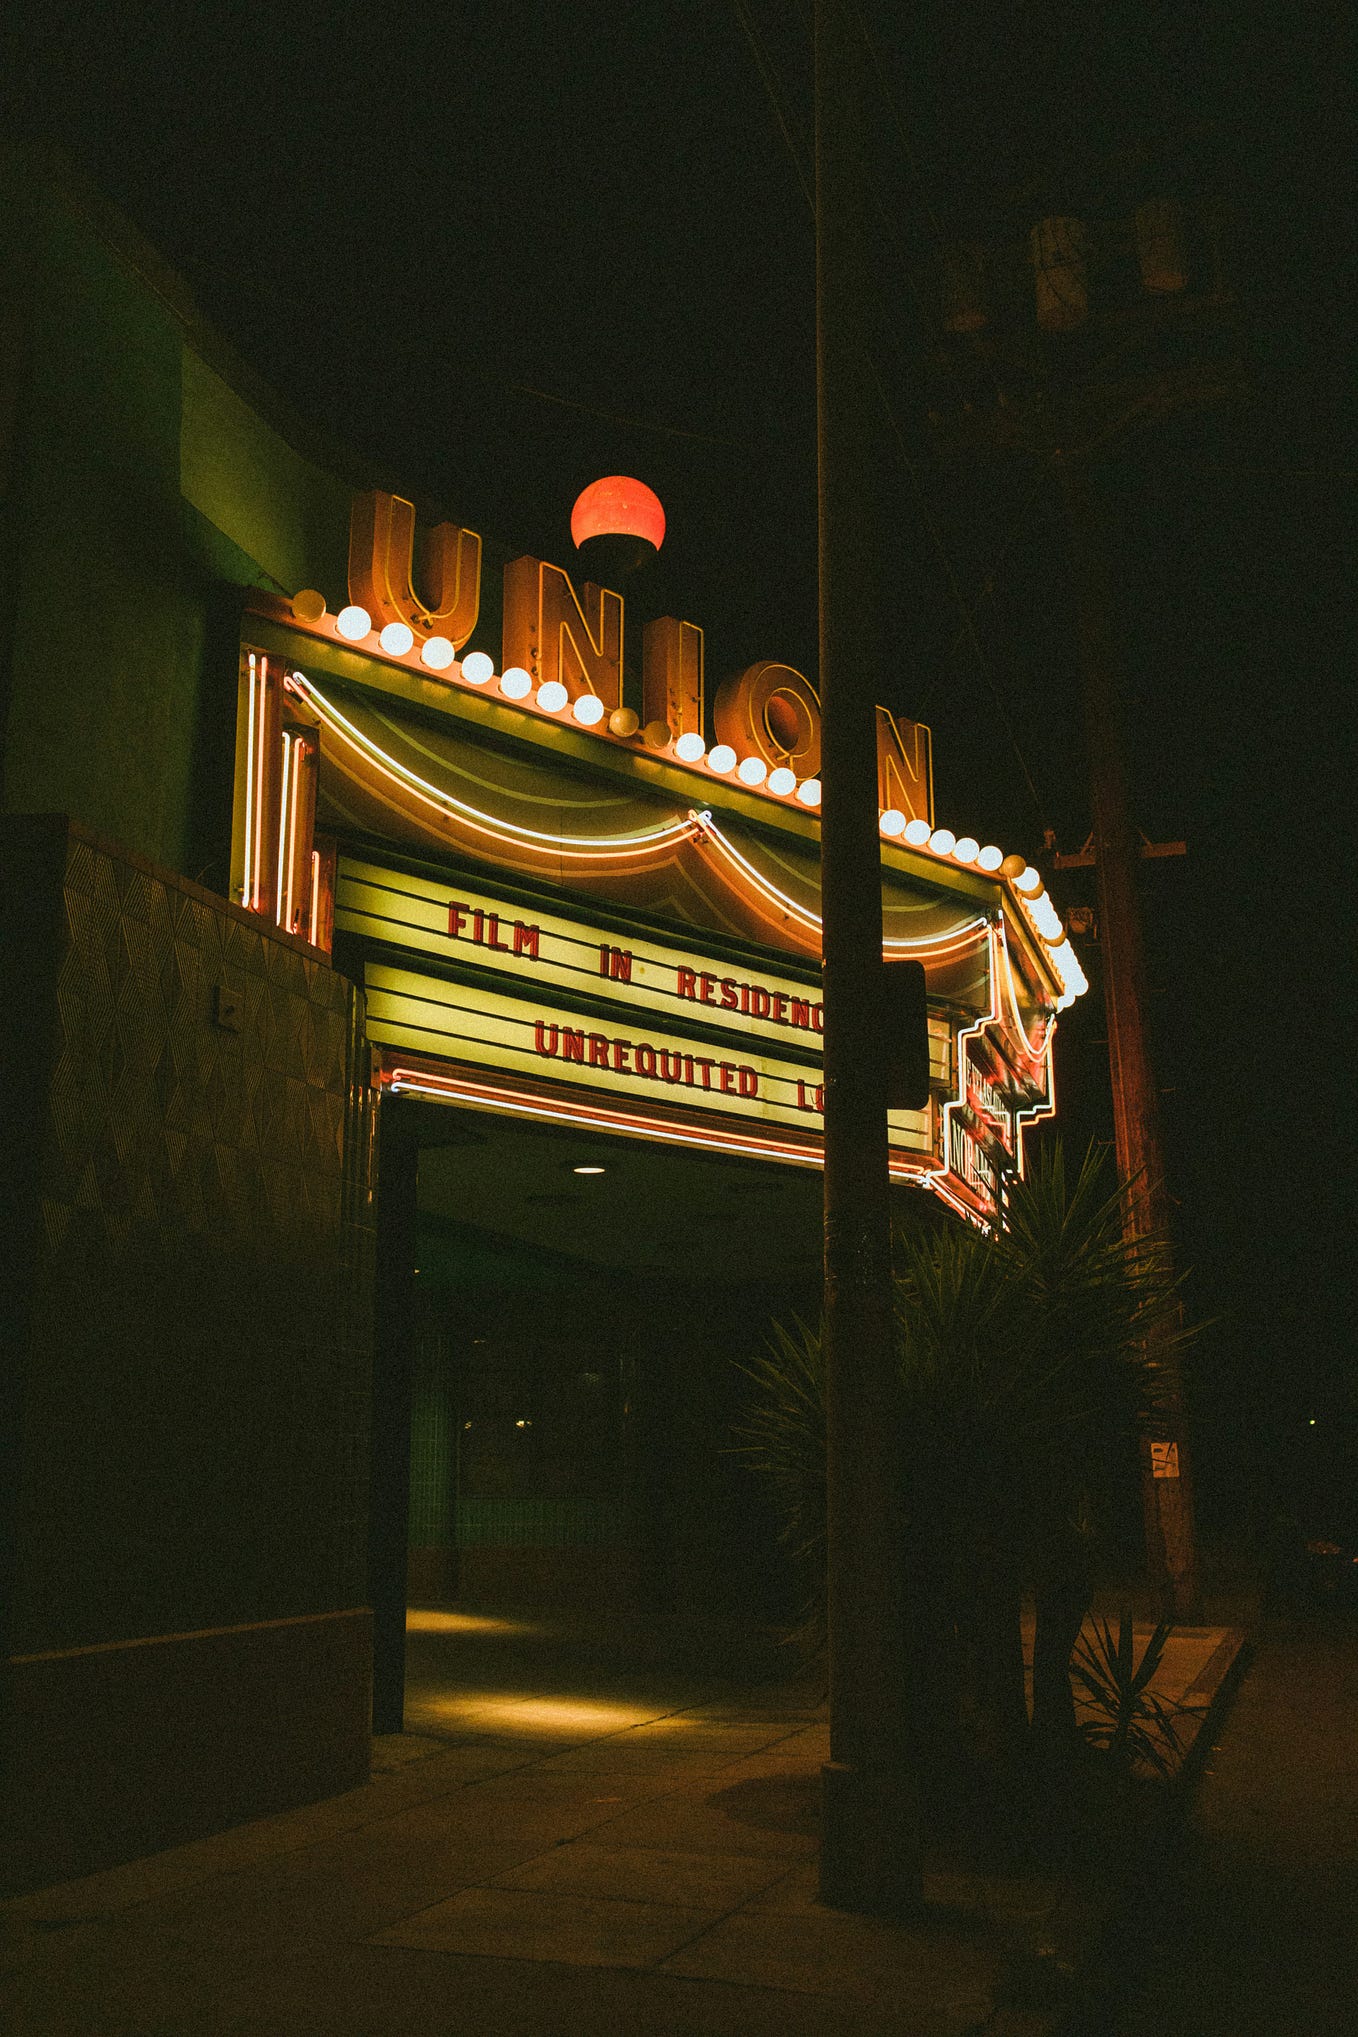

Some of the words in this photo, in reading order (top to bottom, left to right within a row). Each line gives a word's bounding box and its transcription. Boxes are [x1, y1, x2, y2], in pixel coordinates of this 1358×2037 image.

[348, 490, 932, 830] UNION
[448, 901, 540, 961] FILM
[601, 944, 632, 985] IN
[677, 965, 824, 1035] RESIDENC
[534, 1020, 759, 1099] UNREQUITED
